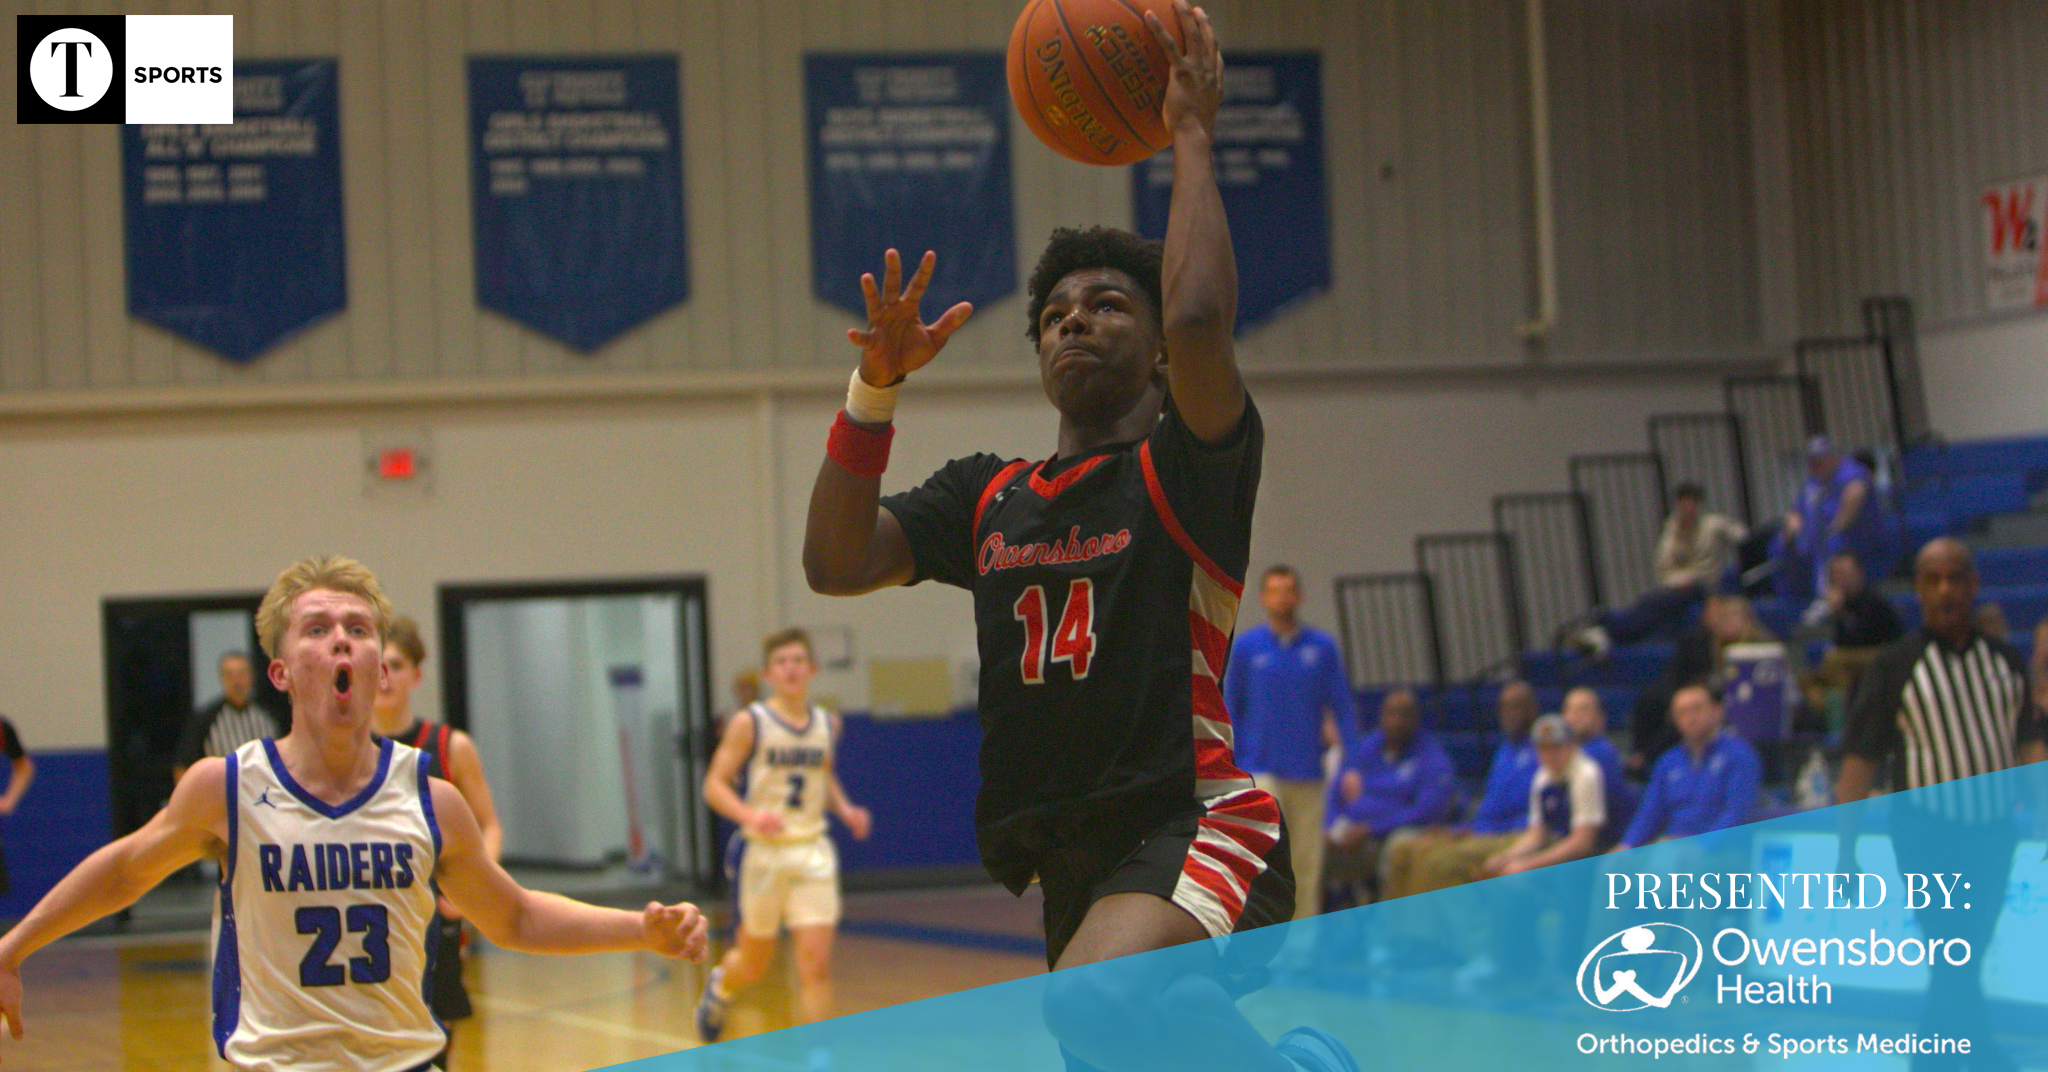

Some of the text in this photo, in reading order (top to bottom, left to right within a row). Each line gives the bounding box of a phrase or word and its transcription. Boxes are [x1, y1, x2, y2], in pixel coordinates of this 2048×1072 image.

[1037, 37, 1128, 155] SPALDING
[1084, 24, 1162, 122] LEGACY
[979, 525, 1132, 575] Owensboro
[1014, 578, 1096, 684] 14
[259, 843, 414, 892] RAIDERS
[295, 904, 391, 987] 23
